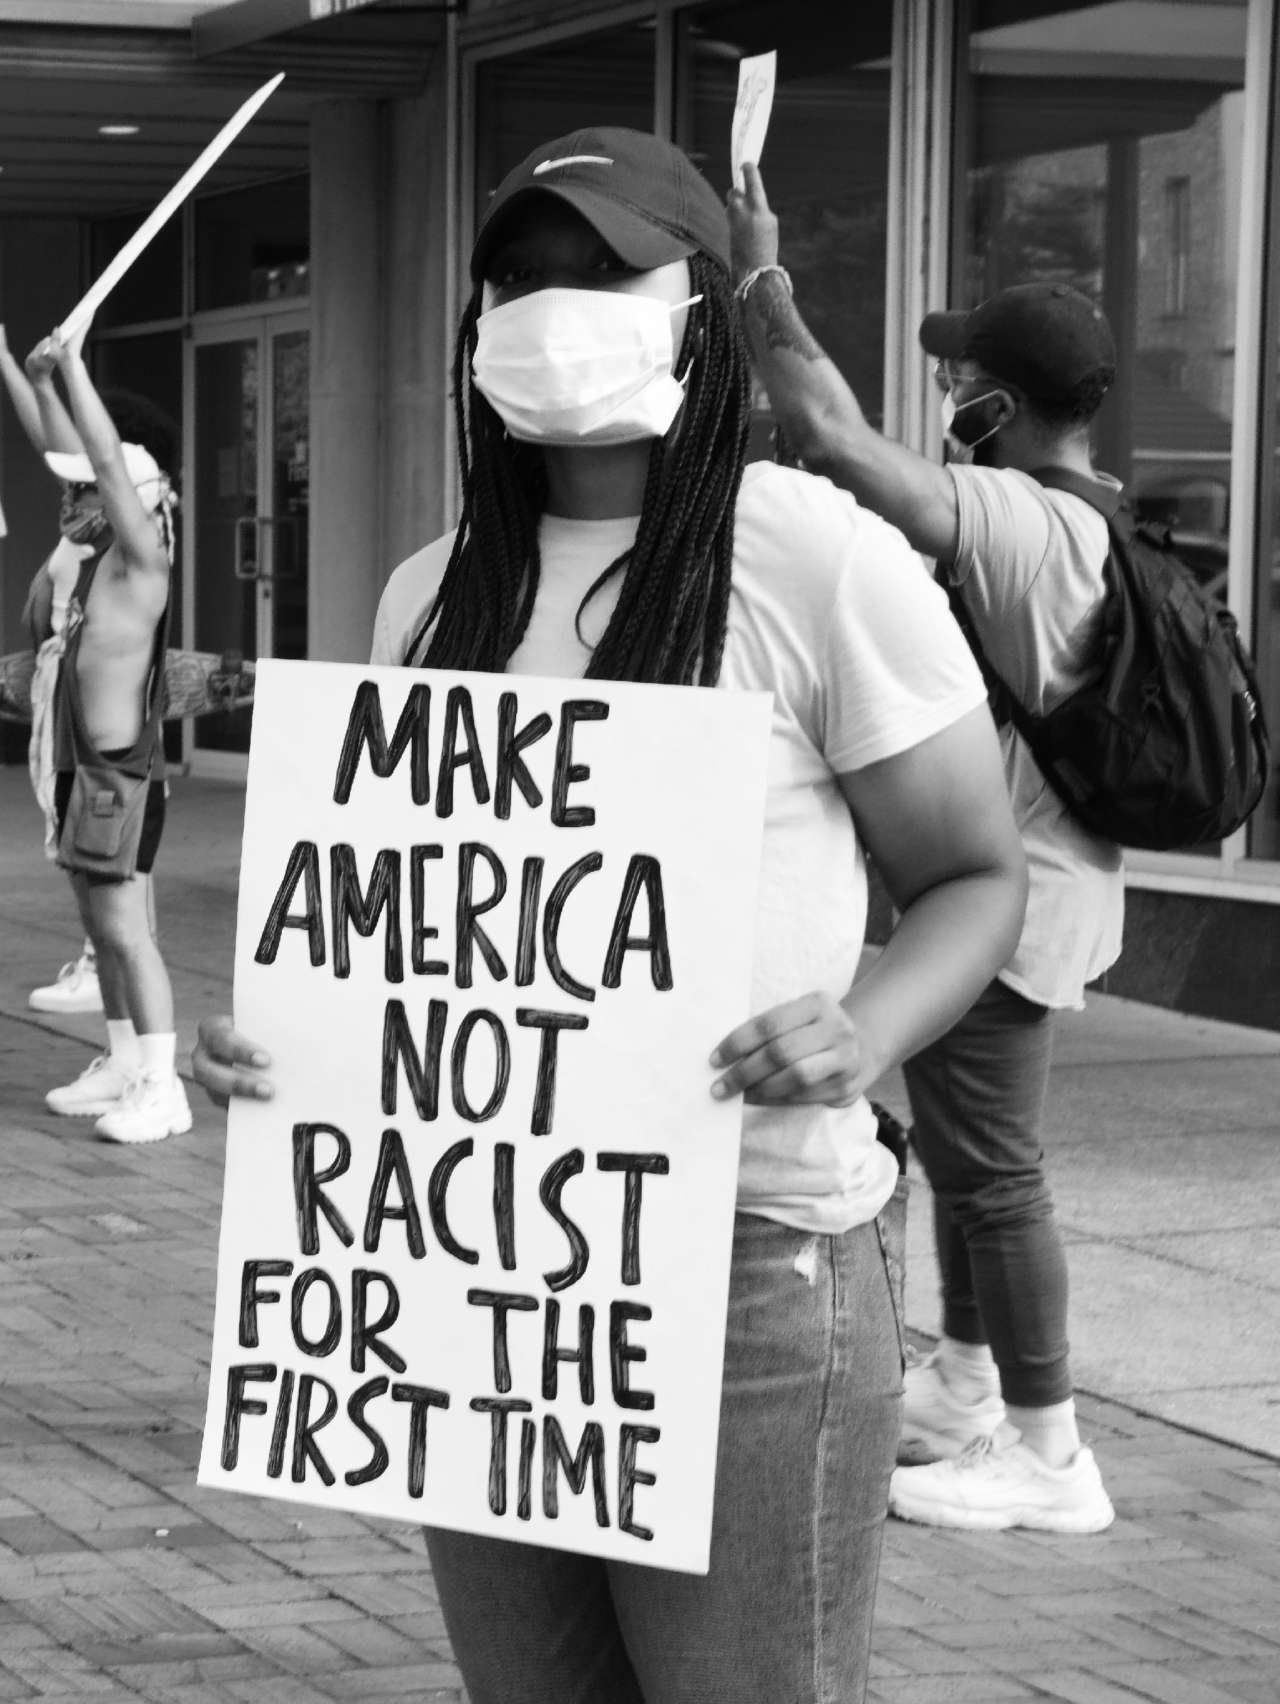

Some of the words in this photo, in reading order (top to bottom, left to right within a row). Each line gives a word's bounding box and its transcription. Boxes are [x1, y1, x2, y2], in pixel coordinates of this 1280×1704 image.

[333, 680, 610, 828] MAKE
[254, 840, 674, 1003] AMERICA
[381, 998, 590, 1137] NOT
[292, 1122, 670, 1293] RACIST
[238, 1259, 407, 1374] FOR
[467, 1288, 655, 1411] THE
[221, 1363, 450, 1499] FIRST
[469, 1397, 661, 1542] TIME
